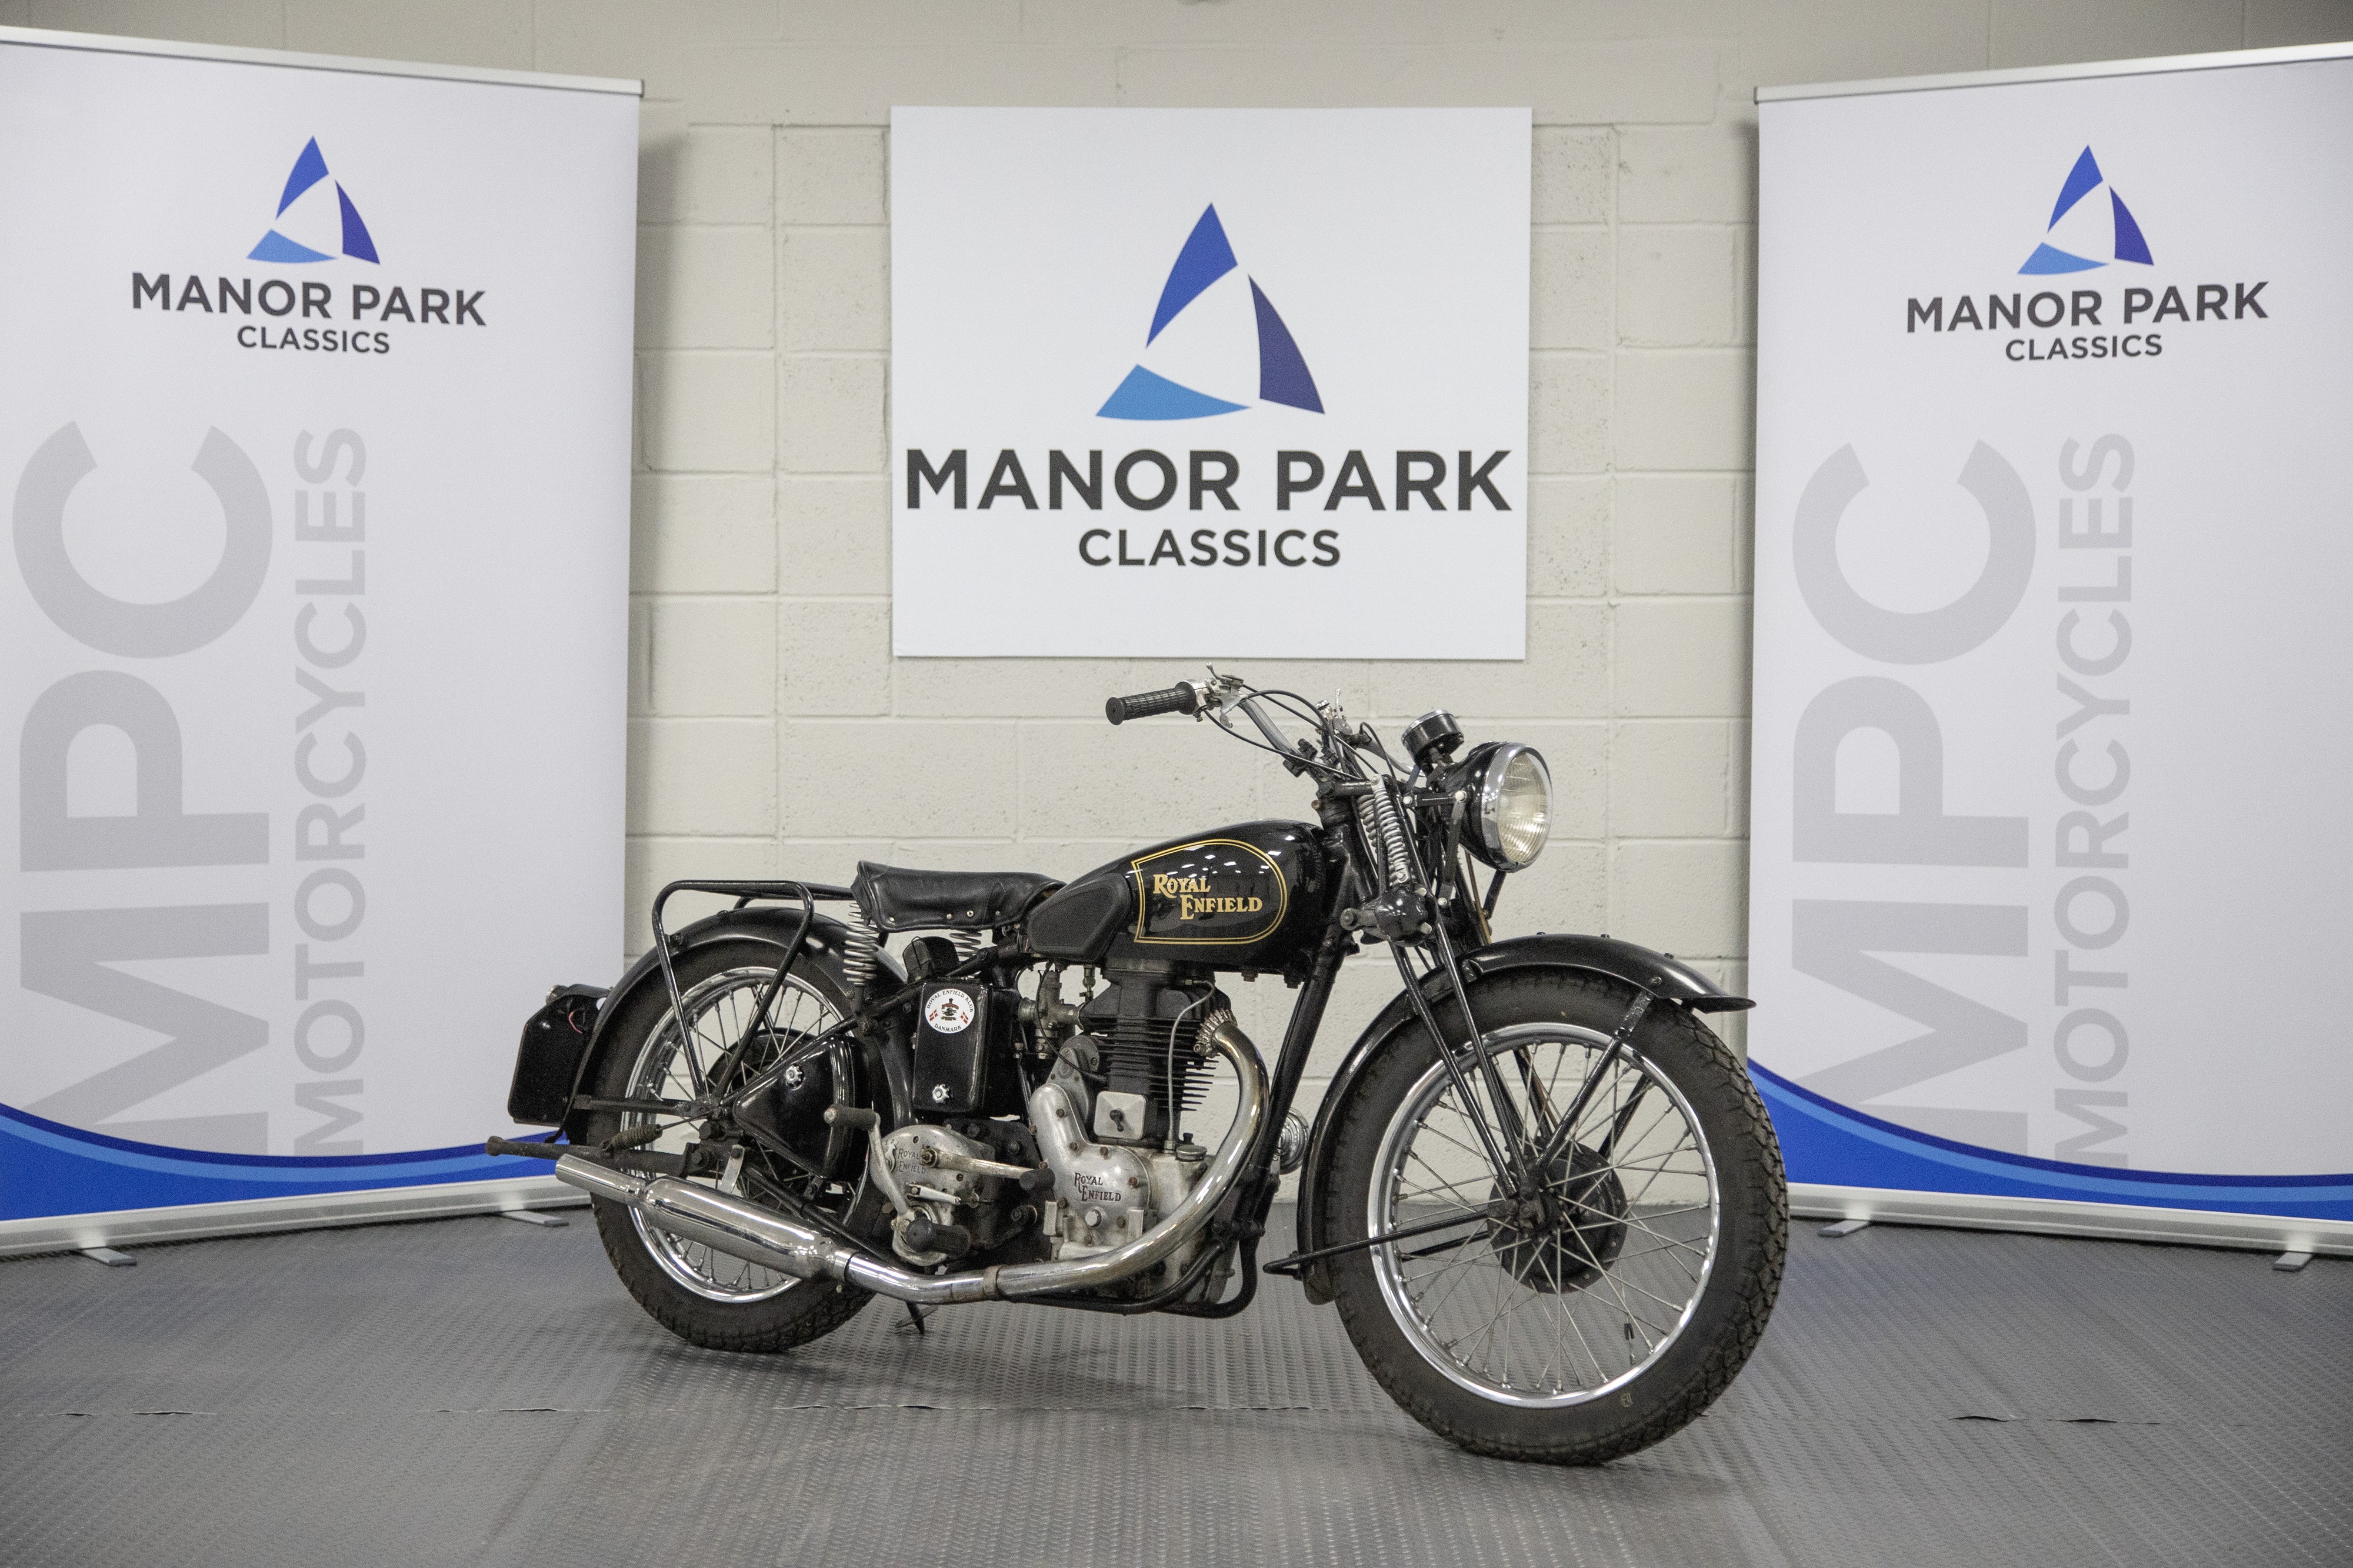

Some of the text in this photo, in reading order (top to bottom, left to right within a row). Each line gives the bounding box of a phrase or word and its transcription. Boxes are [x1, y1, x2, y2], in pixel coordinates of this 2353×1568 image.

[133, 273, 486, 326] MANOR PARK
[1908, 282, 2268, 332] MANOR PARK
[238, 326, 390, 354] CLASSICS
[2006, 334, 2162, 362] CLASSICS
[907, 449, 1511, 511] MANOR PARK
[1079, 529, 1340, 566] CLASSICS
[12, 420, 273, 1156] MPC
[294, 426, 367, 1156] MOTORCYCLES
[1791, 438, 2037, 1156] MPC
[2053, 432, 2135, 1168] MOTORCYCLES
[1153, 873, 1211, 899] ROYAL
[1180, 894, 1263, 920] ENFIELD
[926, 990, 974, 1013] ROYAL ENFIELD KLUB
[934, 1023, 962, 1032] DANMARK
[898, 1148, 919, 1160] ROYAL
[899, 1161, 926, 1174] ENFIELD
[1074, 1172, 1103, 1193] ROYAL
[1081, 1185, 1122, 1202] ENFIELD
